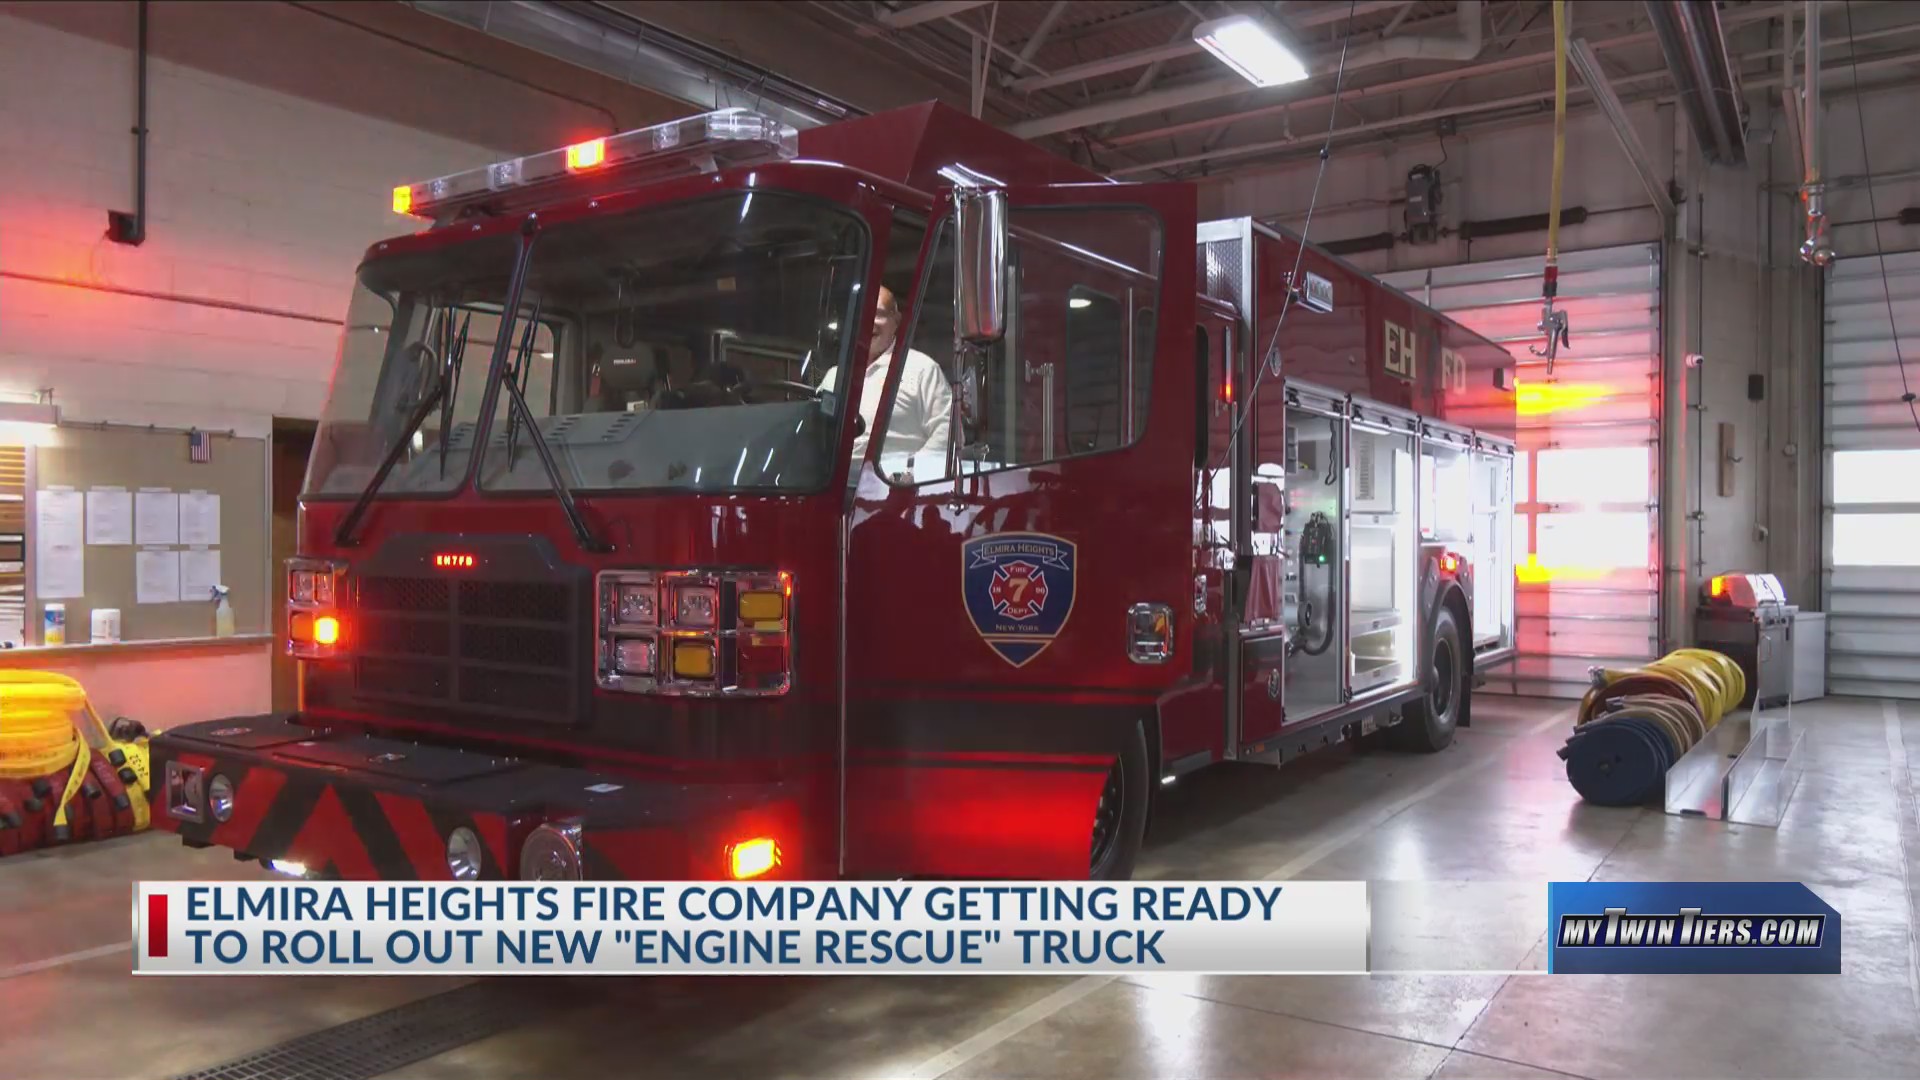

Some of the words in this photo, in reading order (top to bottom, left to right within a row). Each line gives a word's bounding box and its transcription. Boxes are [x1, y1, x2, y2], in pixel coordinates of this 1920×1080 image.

[1384, 319, 1417, 379] EH
[1441, 347, 1467, 396] FD
[984, 545, 1016, 556] ELMIRA
[1018, 543, 1055, 556] HEIGHTS
[1009, 578, 1029, 603] 7
